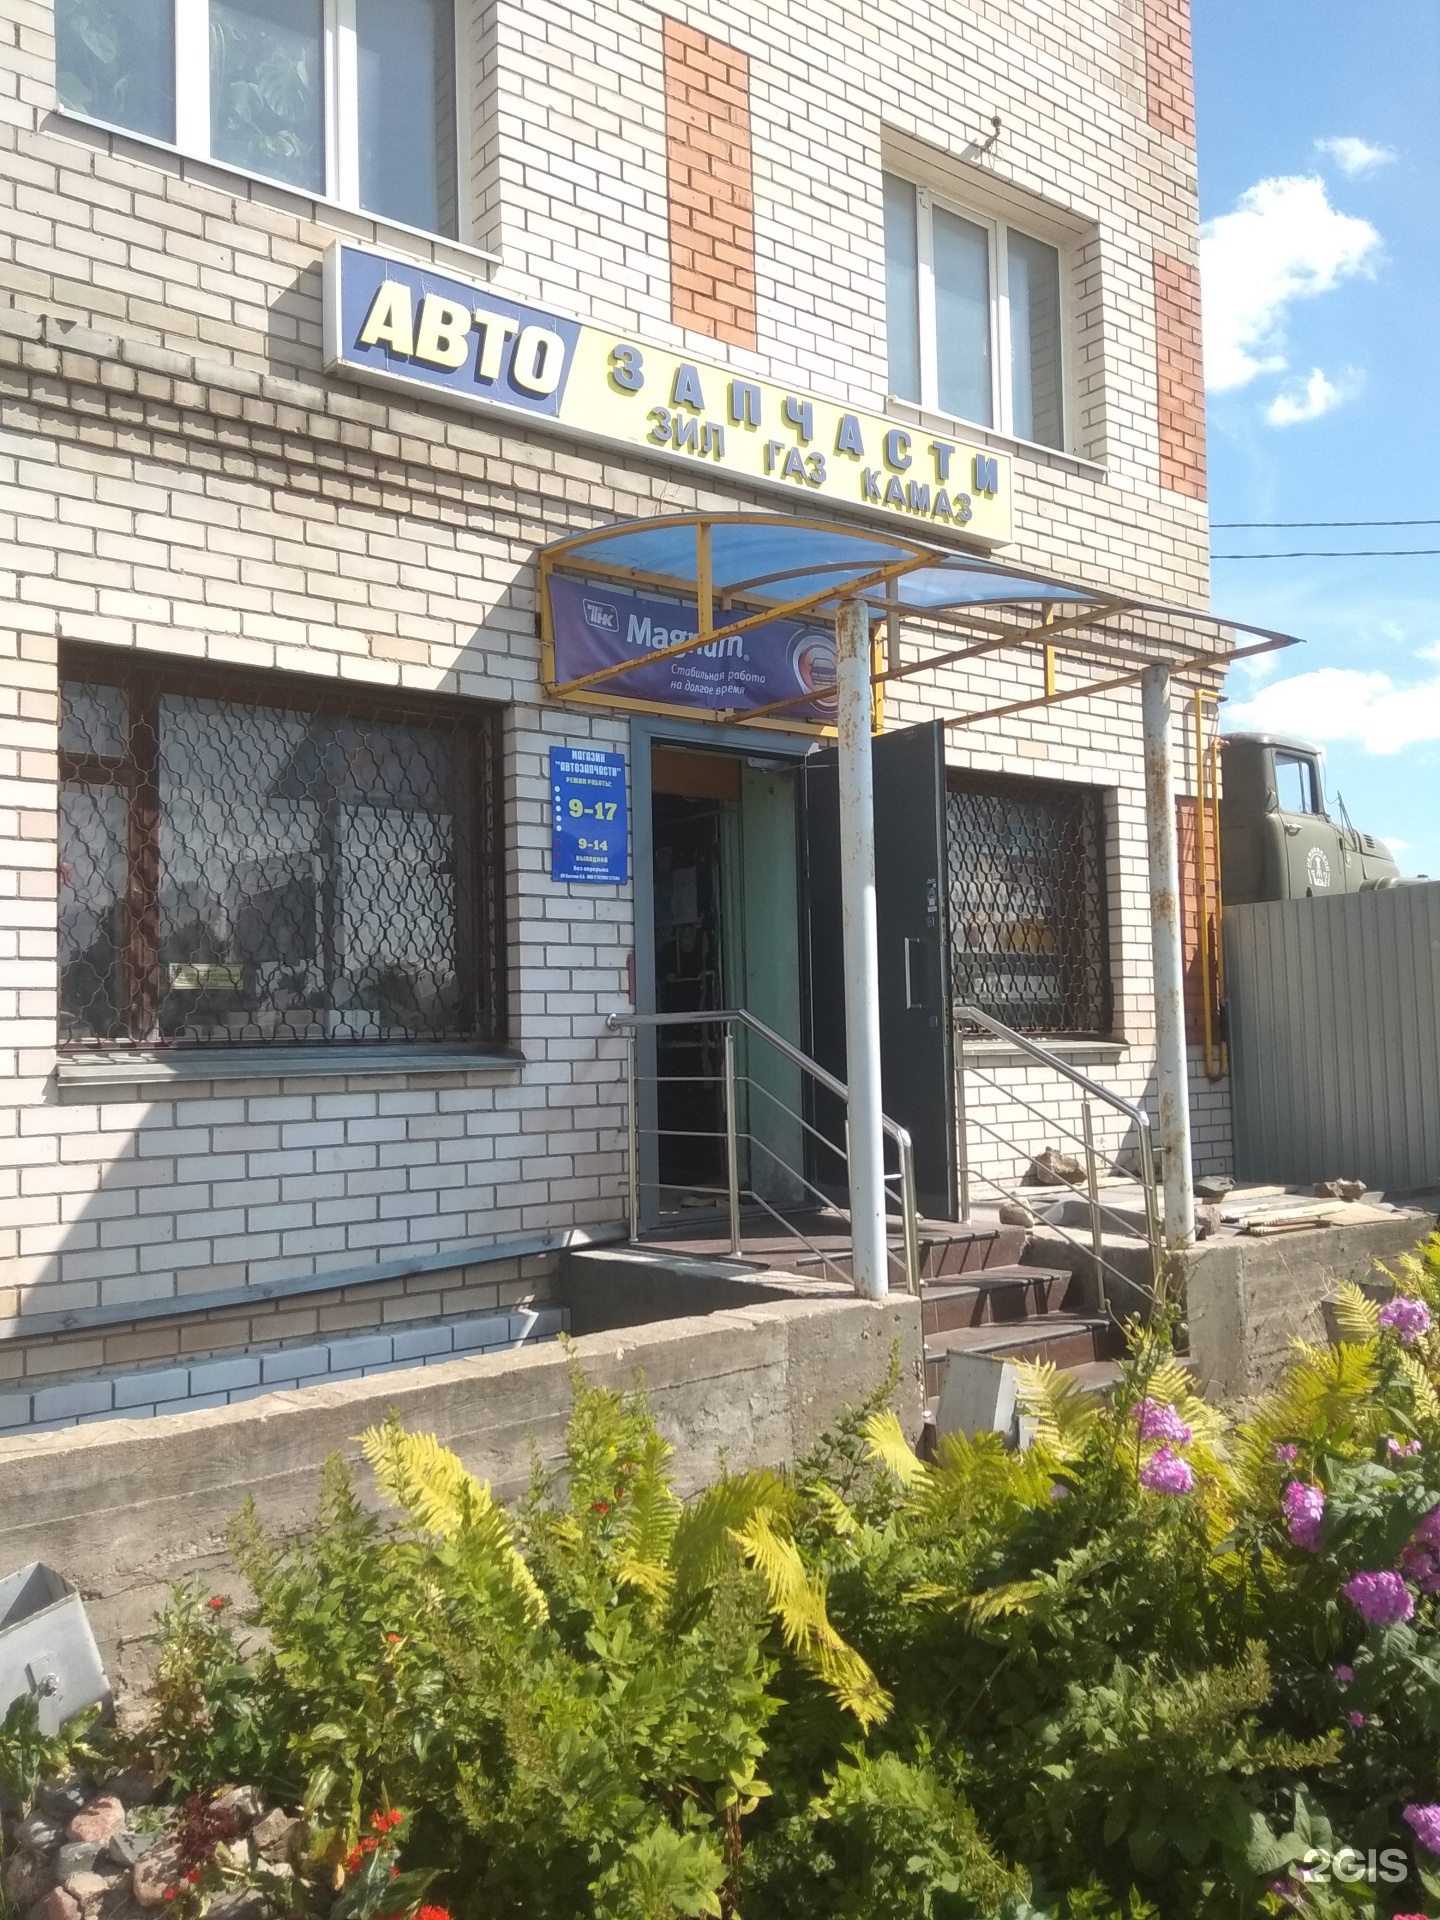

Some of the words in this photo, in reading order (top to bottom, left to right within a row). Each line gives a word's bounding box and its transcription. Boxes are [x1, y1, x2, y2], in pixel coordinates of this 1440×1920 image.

[358, 279, 566, 396] АВТО
[611, 343, 999, 494] ЗАПЧАСТИ
[650, 406, 726, 457] ЗИЛ
[768, 439, 828, 484] ГАЗ
[864, 467, 973, 522] КАМАЗ
[671, 663, 725, 682] Стабильная
[727, 669, 766, 684] работа
[670, 680, 682, 690] на
[684, 679, 714, 695] долгое
[715, 685, 746, 697] время
[571, 750, 606, 763] МАГАЗИН
[568, 798, 618, 821] 9-17
[577, 838, 608, 851] 9-14
